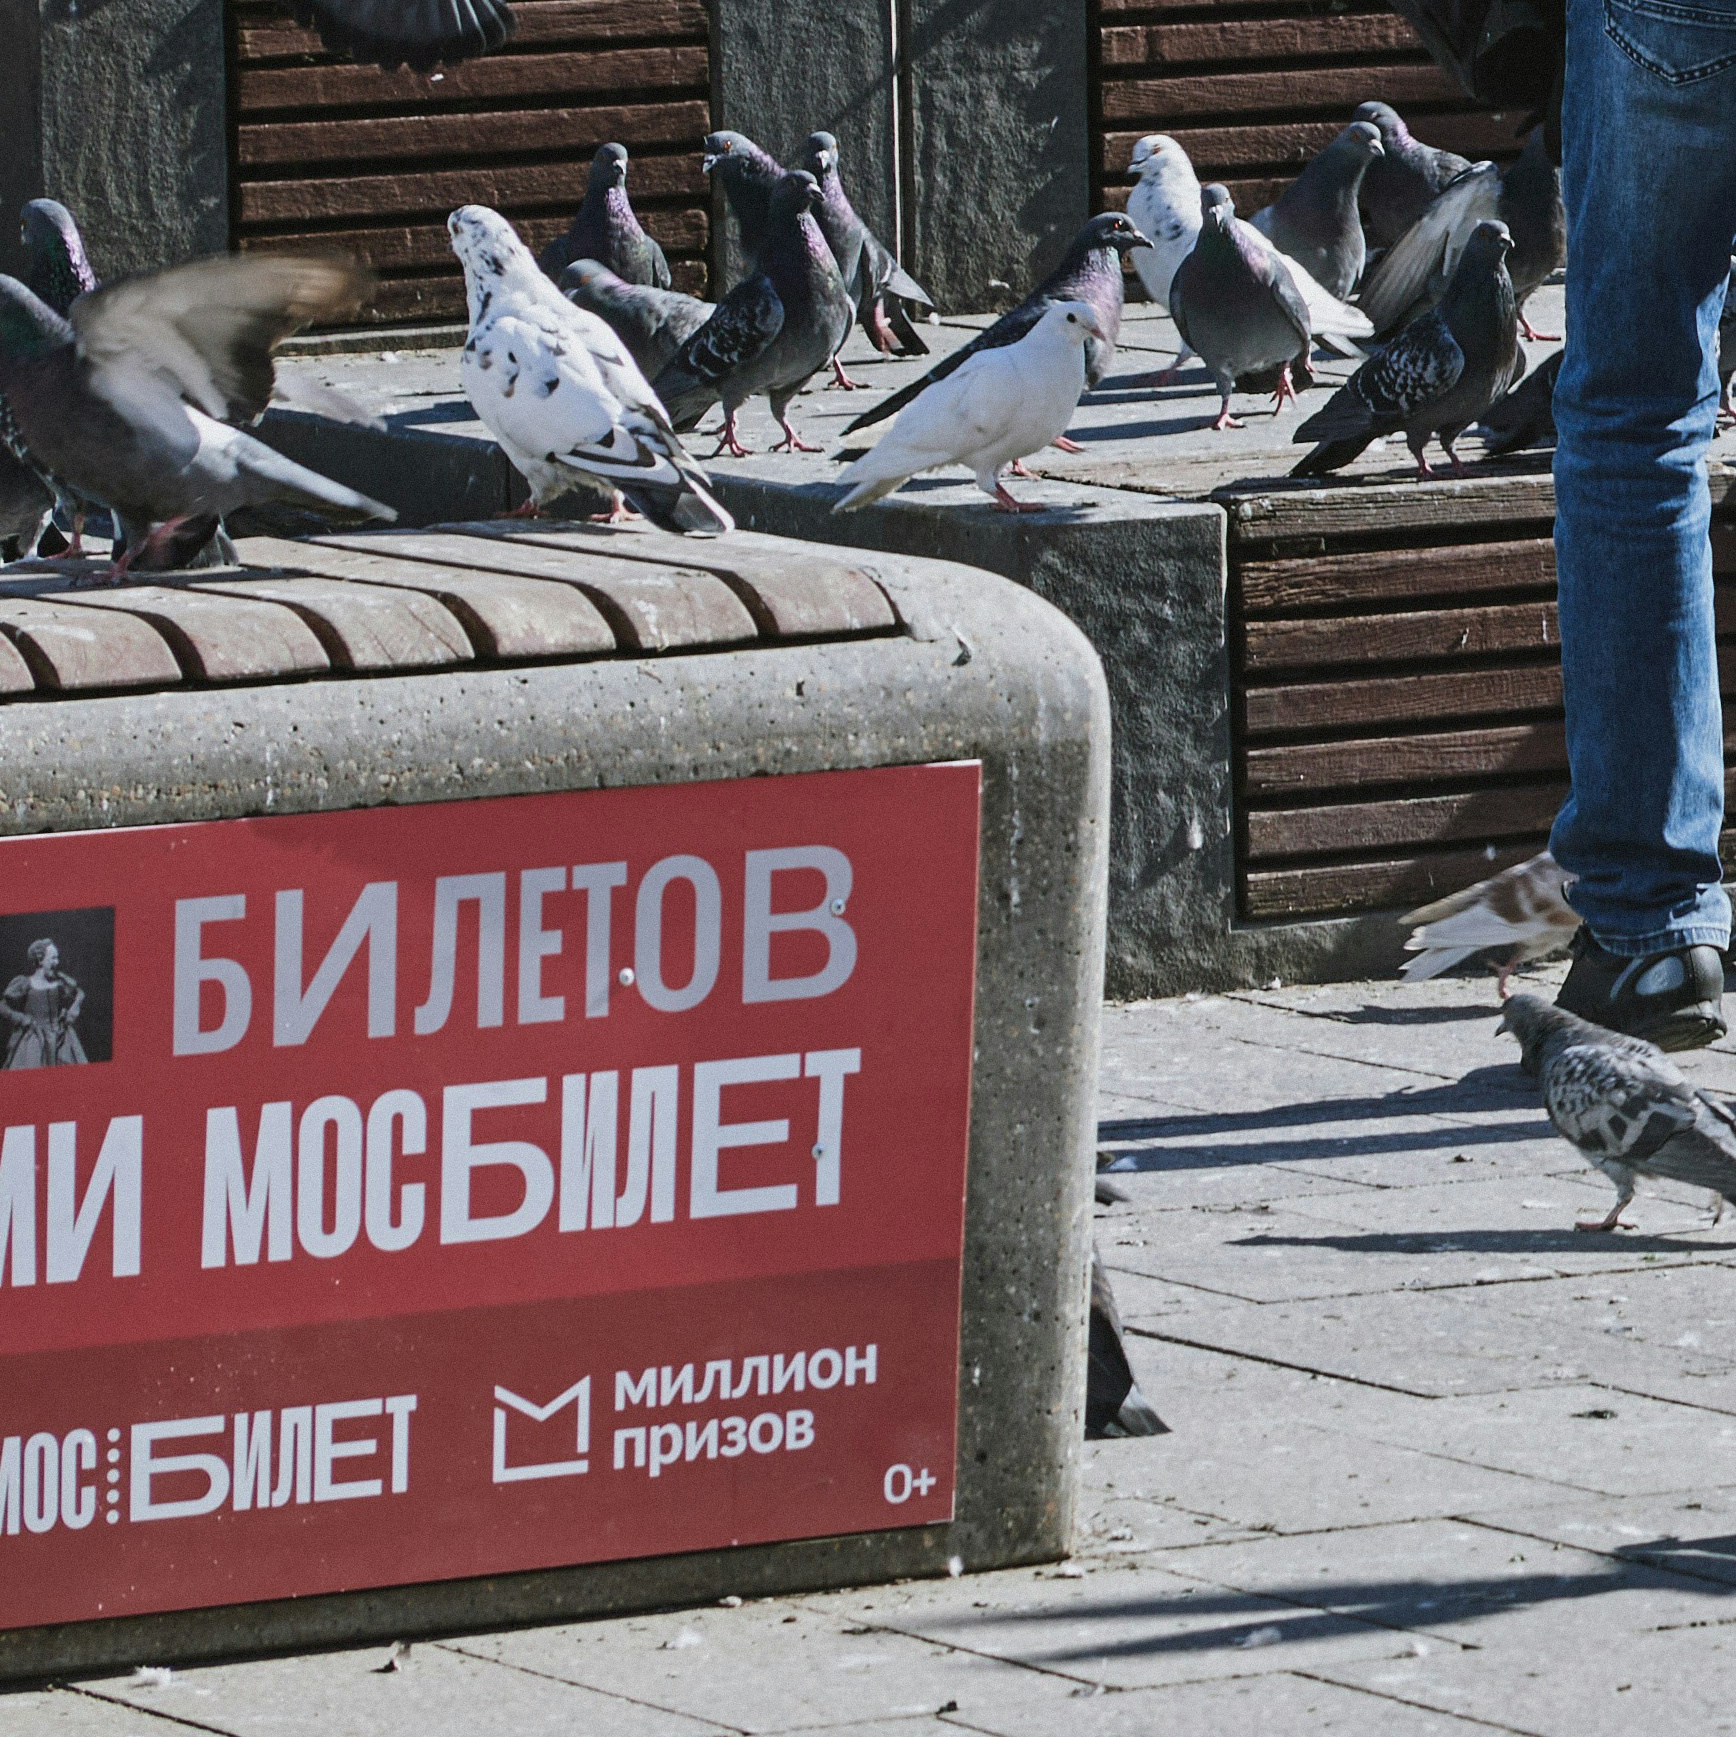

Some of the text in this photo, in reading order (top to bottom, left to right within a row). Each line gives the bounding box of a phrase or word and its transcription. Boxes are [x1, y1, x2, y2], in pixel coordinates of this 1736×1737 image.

[173, 845, 858, 1057] БИЛЕТОВ
[200, 1047, 862, 1270] МОСБИЛЕТ
[613, 1409, 816, 1478] призов
[883, 1463, 938, 1504] 0+
